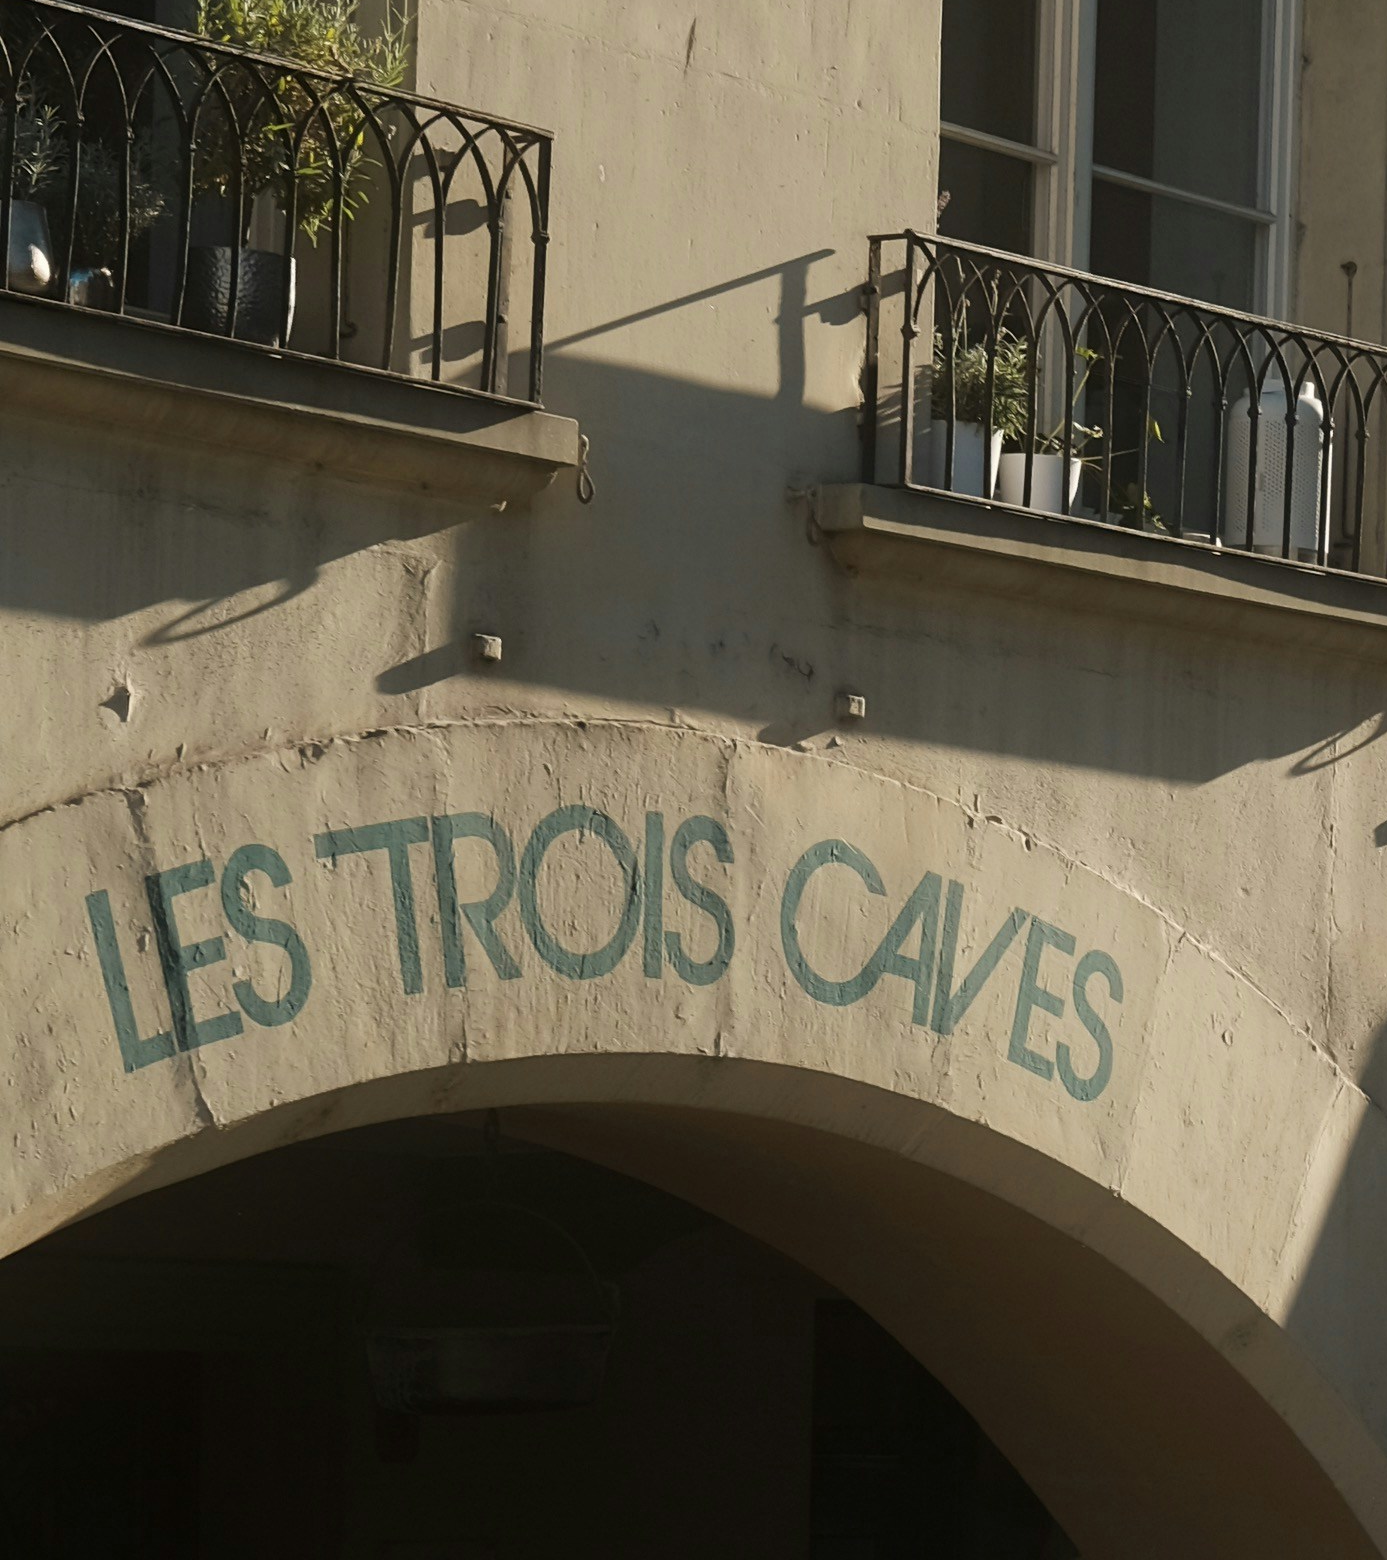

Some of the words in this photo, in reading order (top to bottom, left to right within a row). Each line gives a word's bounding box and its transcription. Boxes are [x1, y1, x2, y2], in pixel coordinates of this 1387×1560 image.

[85, 843, 312, 1074] LES
[315, 805, 735, 996] TROIS
[780, 839, 1124, 1102] CAVES
